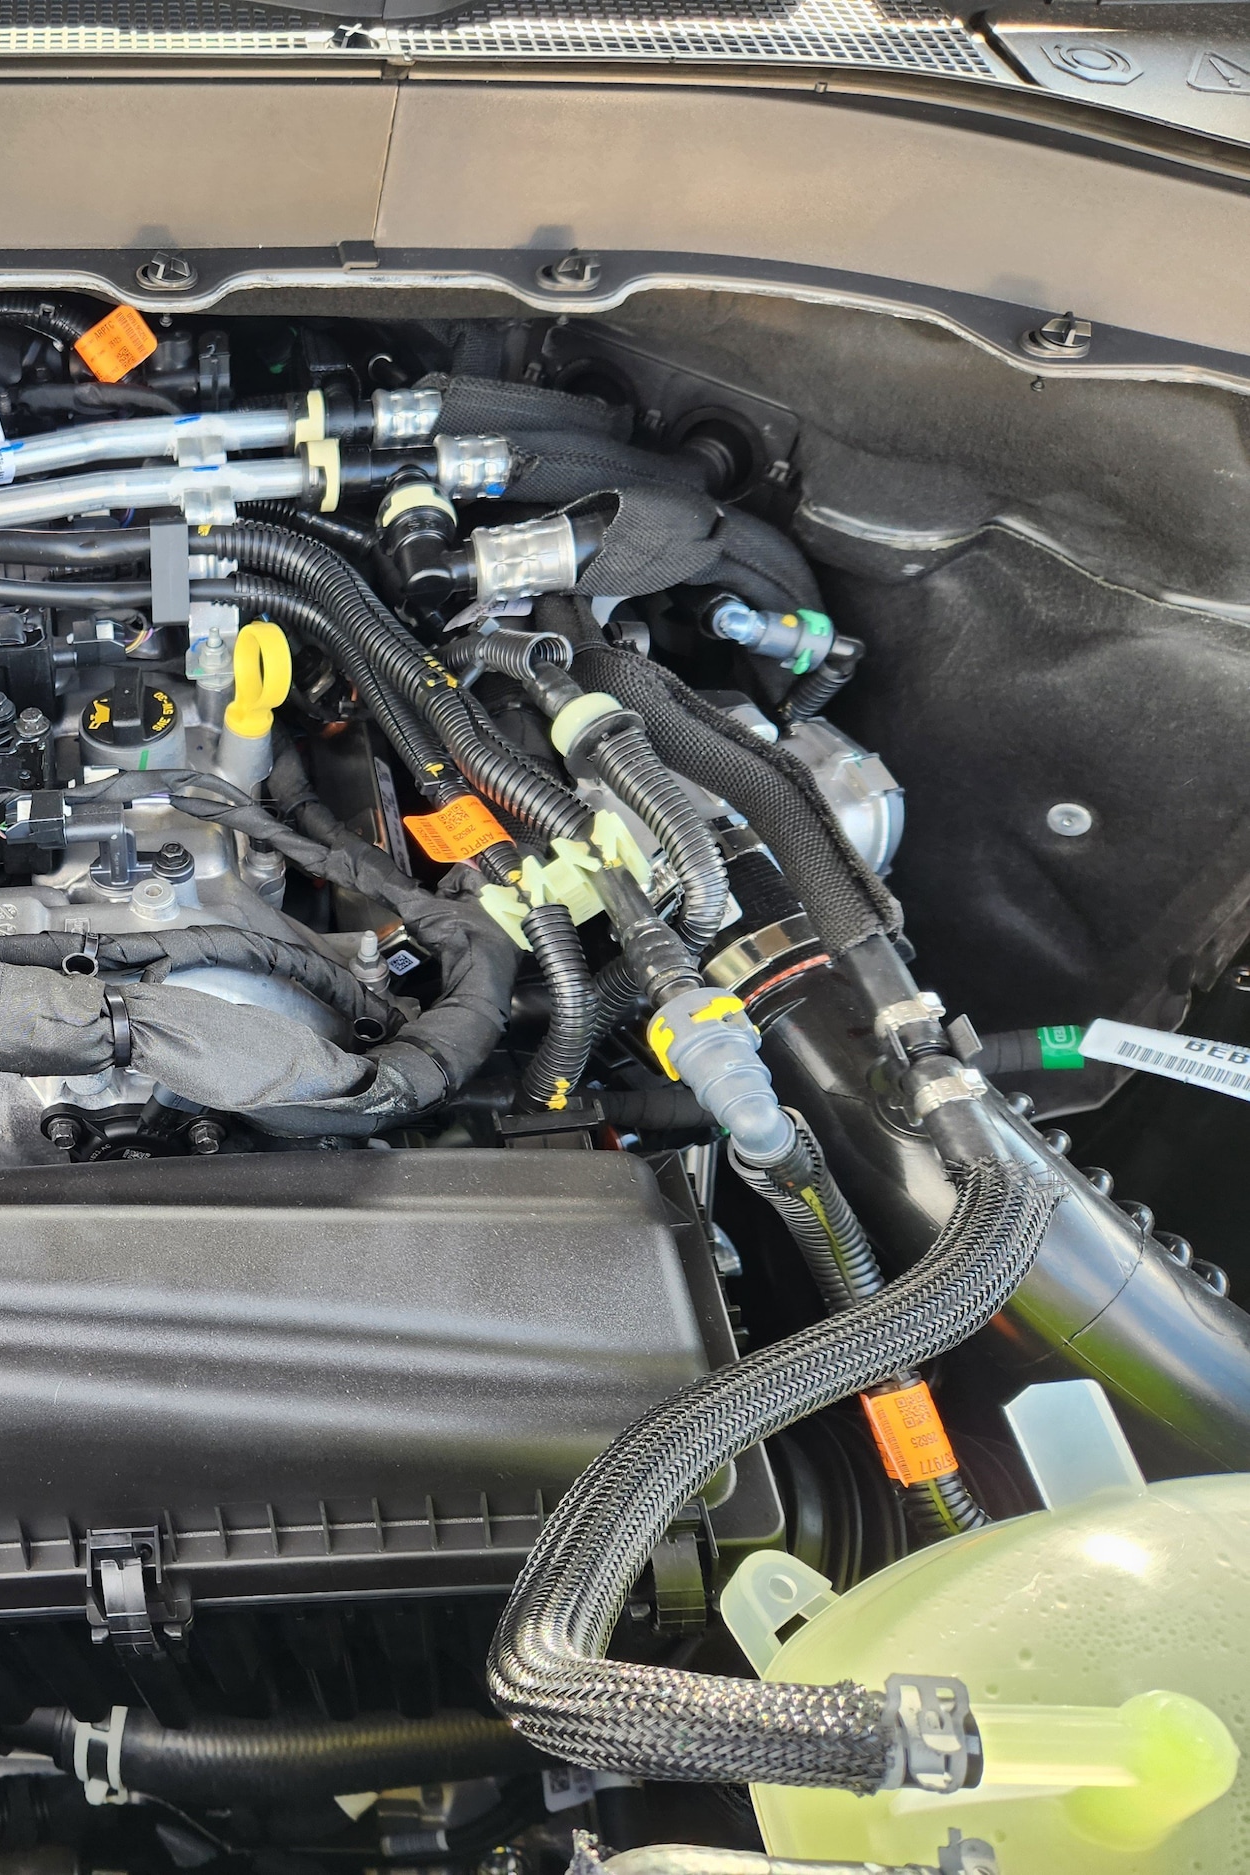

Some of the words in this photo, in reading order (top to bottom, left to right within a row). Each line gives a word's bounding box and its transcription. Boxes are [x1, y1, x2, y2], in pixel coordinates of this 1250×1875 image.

[94, 321, 115, 341] ARPTC
[153, 691, 175, 715] 5W-30
[152, 717, 172, 732] SAE
[453, 825, 477, 841] 26525
[461, 832, 495, 856] ARPTC
[911, 1432, 939, 1448] 26625
